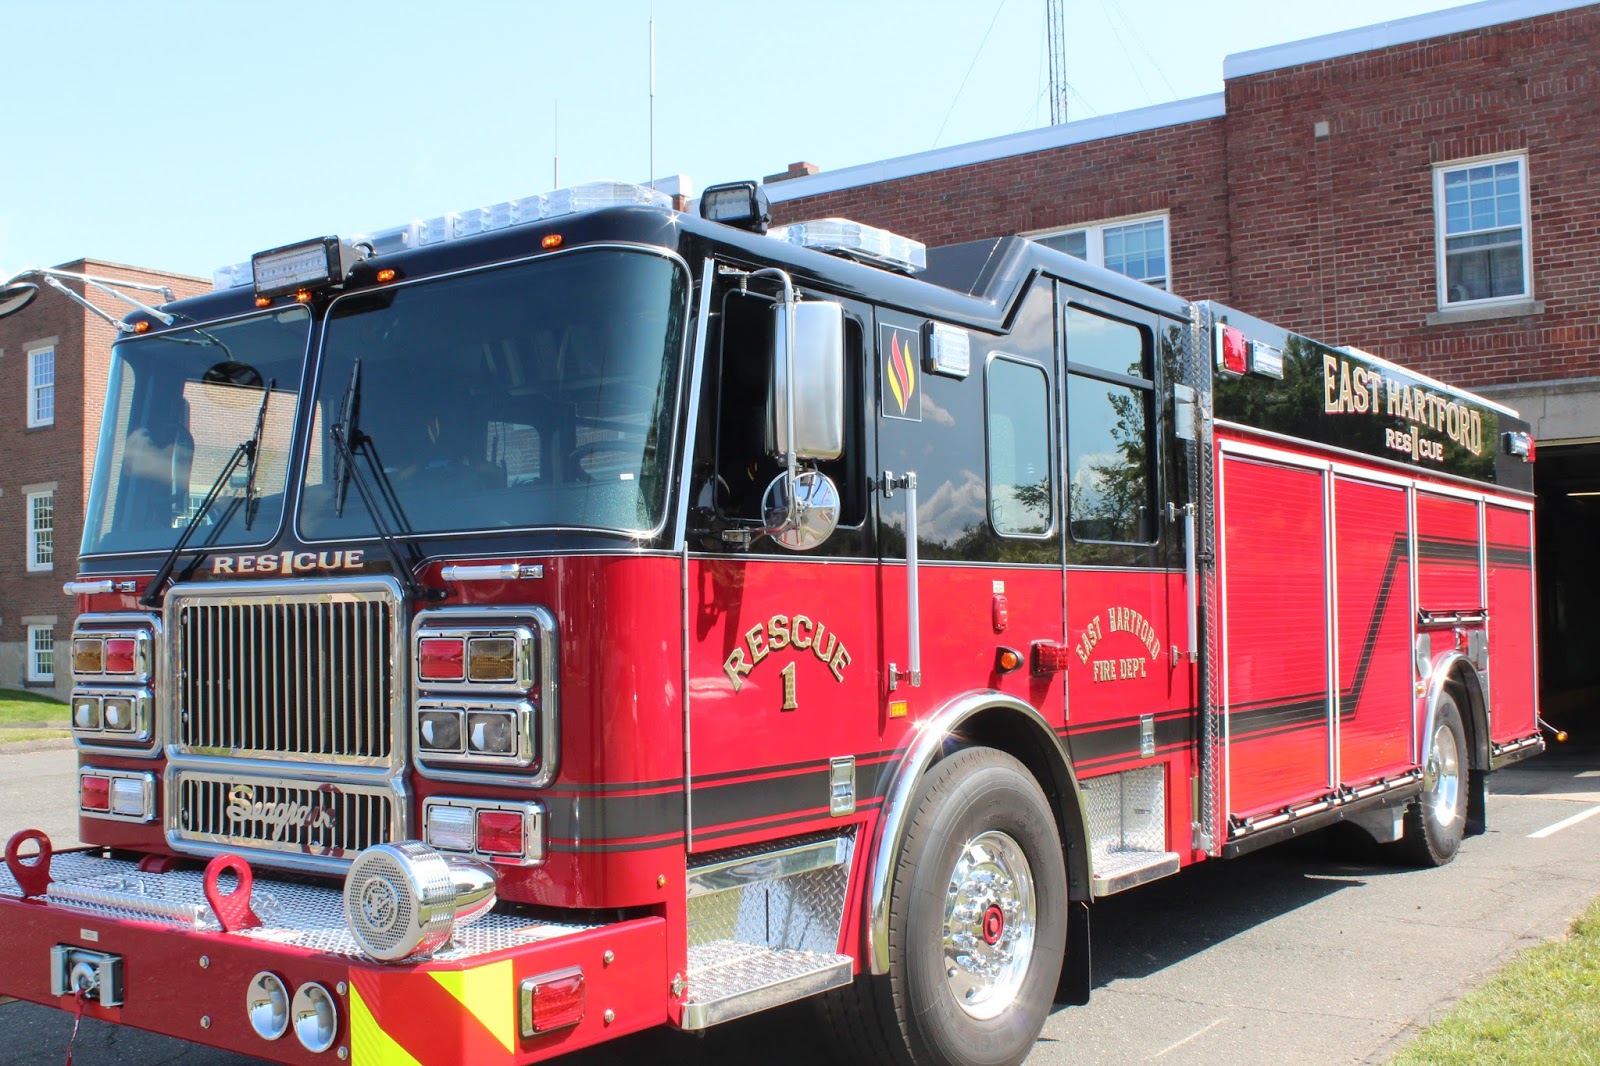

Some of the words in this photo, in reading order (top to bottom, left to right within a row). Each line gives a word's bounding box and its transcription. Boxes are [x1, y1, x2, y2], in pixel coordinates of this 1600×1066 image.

[1323, 354, 1382, 414] EAST
[1386, 377, 1482, 457] HARTFORD
[723, 614, 852, 694] RESCUE
[1075, 615, 1102, 665] EAST
[1108, 606, 1161, 660] HARTFORD
[780, 661, 798, 712] 1
[1092, 660, 1116, 682] FIRE
